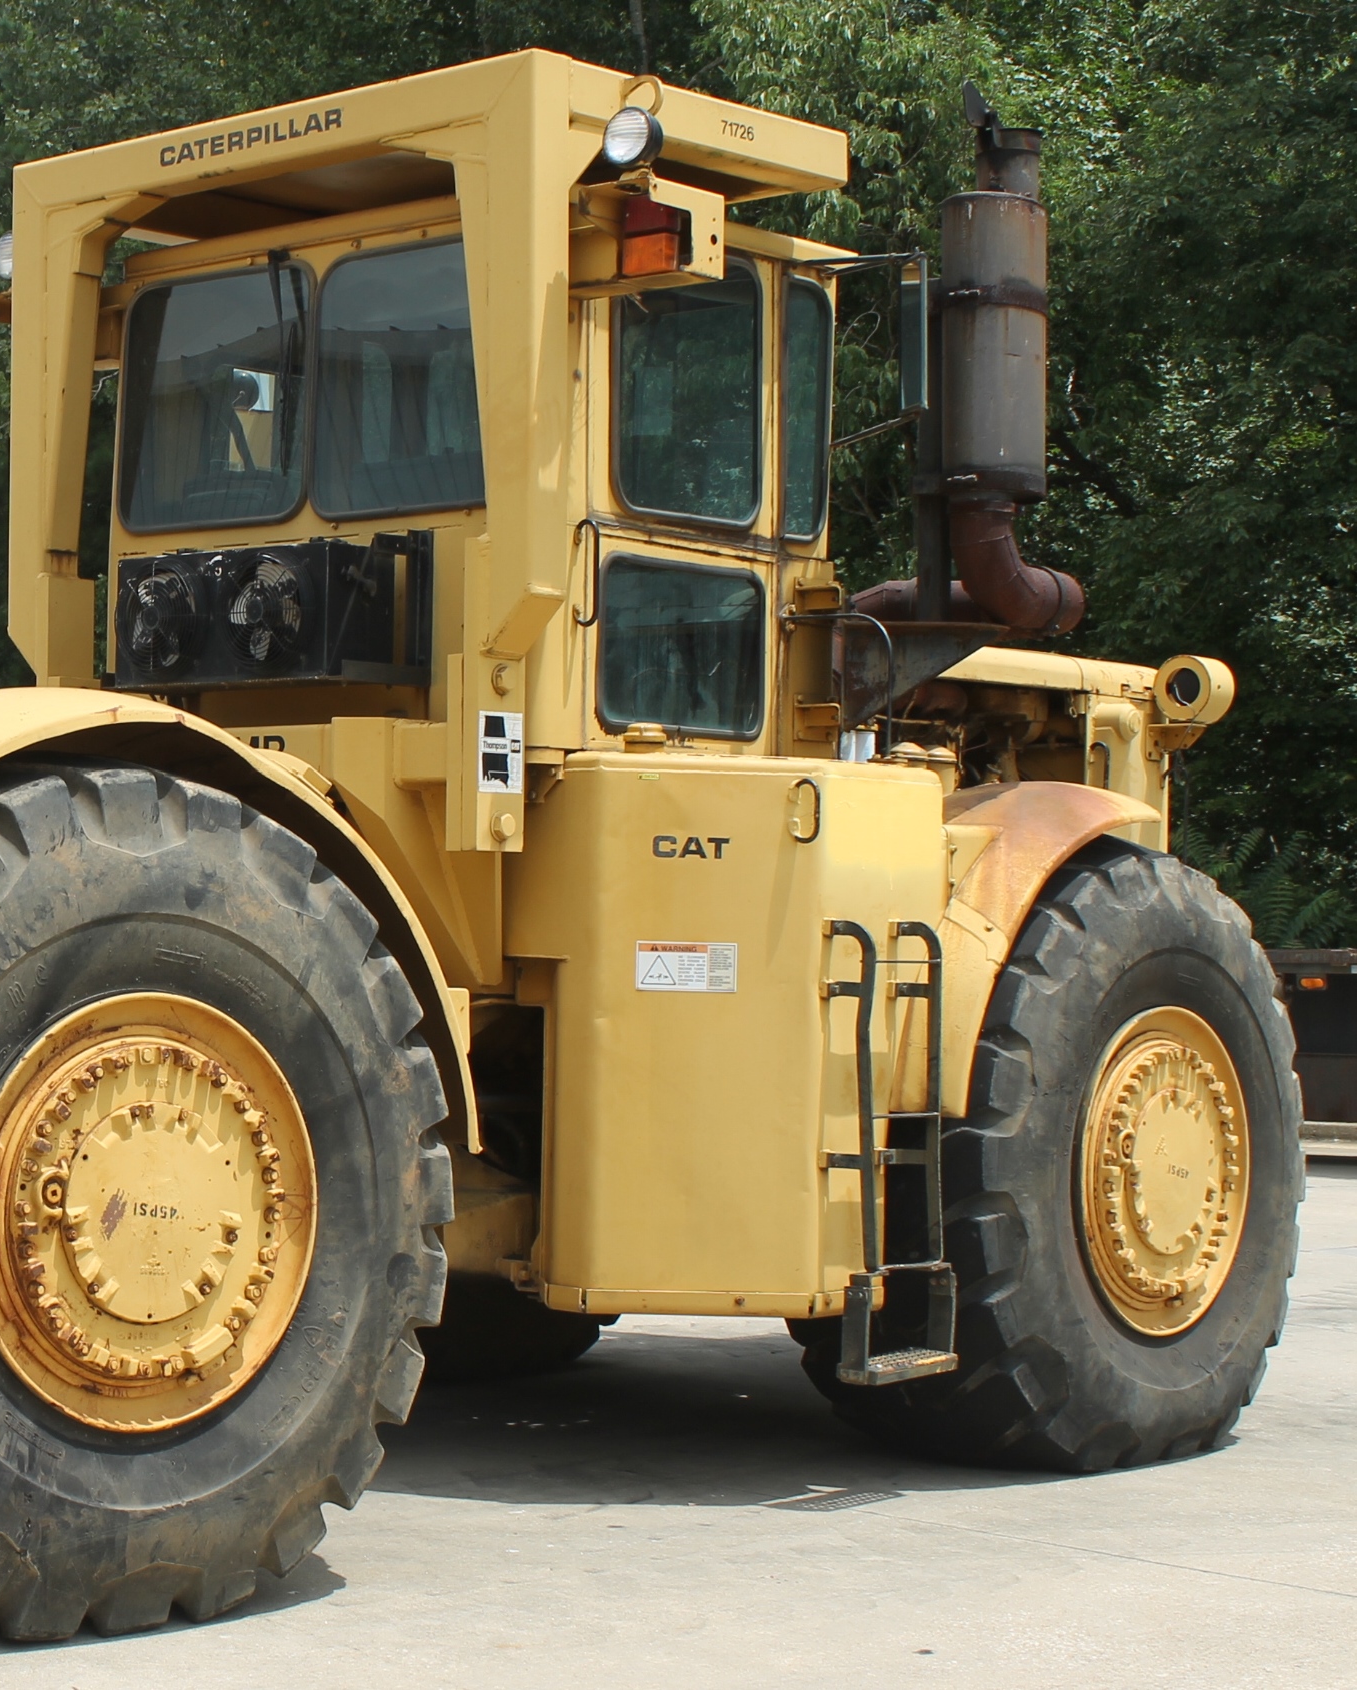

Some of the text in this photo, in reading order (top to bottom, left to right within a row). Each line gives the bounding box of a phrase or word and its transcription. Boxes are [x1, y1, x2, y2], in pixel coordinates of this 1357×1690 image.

[159, 107, 343, 168] CATERPILLAR
[720, 119, 755, 142] 71726
[482, 740, 508, 752] Thompson
[652, 835, 731, 859] CAT
[660, 945, 698, 953] WARNING
[133, 1202, 178, 1220] 45PSI
